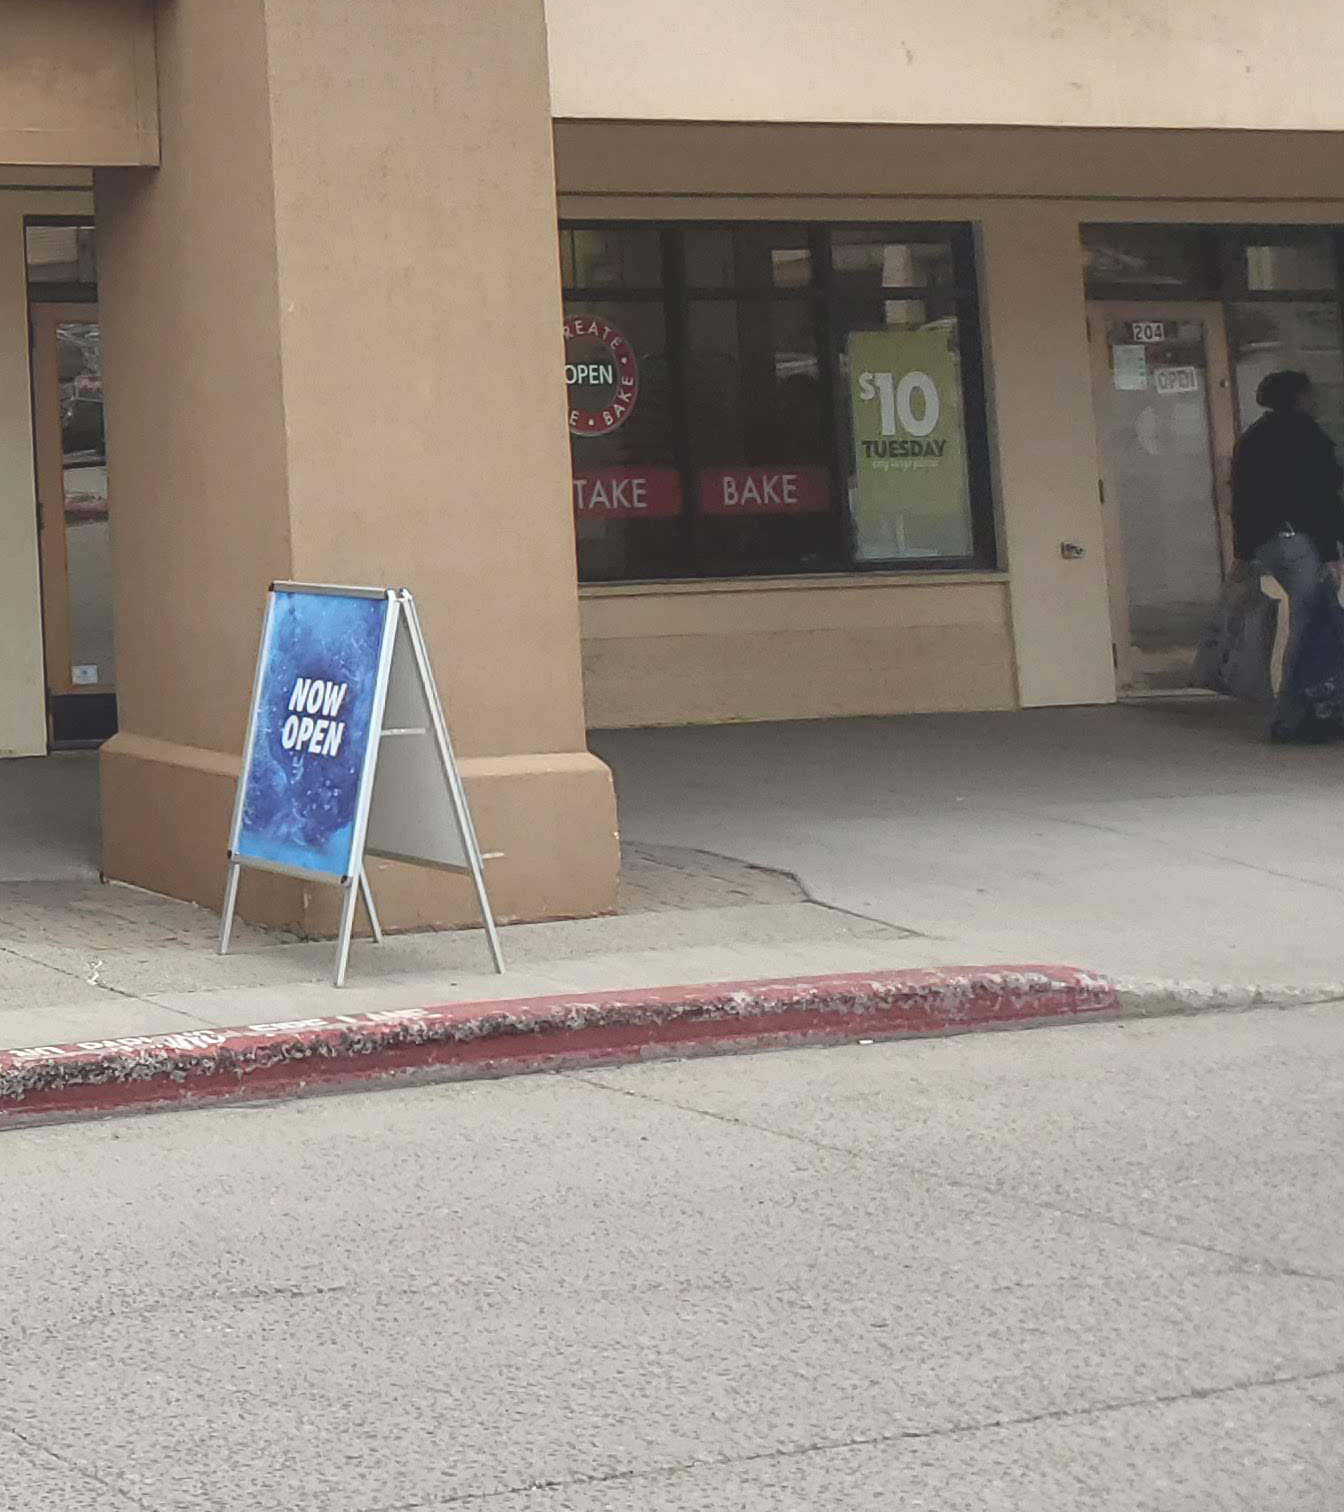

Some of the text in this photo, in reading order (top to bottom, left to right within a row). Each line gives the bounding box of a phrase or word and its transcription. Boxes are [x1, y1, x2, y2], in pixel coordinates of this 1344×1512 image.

[563, 319, 623, 349] REATE
[1134, 324, 1162, 340] 204
[564, 364, 613, 384] OPEN
[602, 375, 634, 426] BAKE
[858, 371, 940, 437] $10
[861, 439, 947, 458] TUESDAY
[573, 478, 647, 509] TAKE
[723, 474, 798, 506] BAKE
[288, 677, 347, 718] NOW
[281, 715, 345, 757] OPEN
